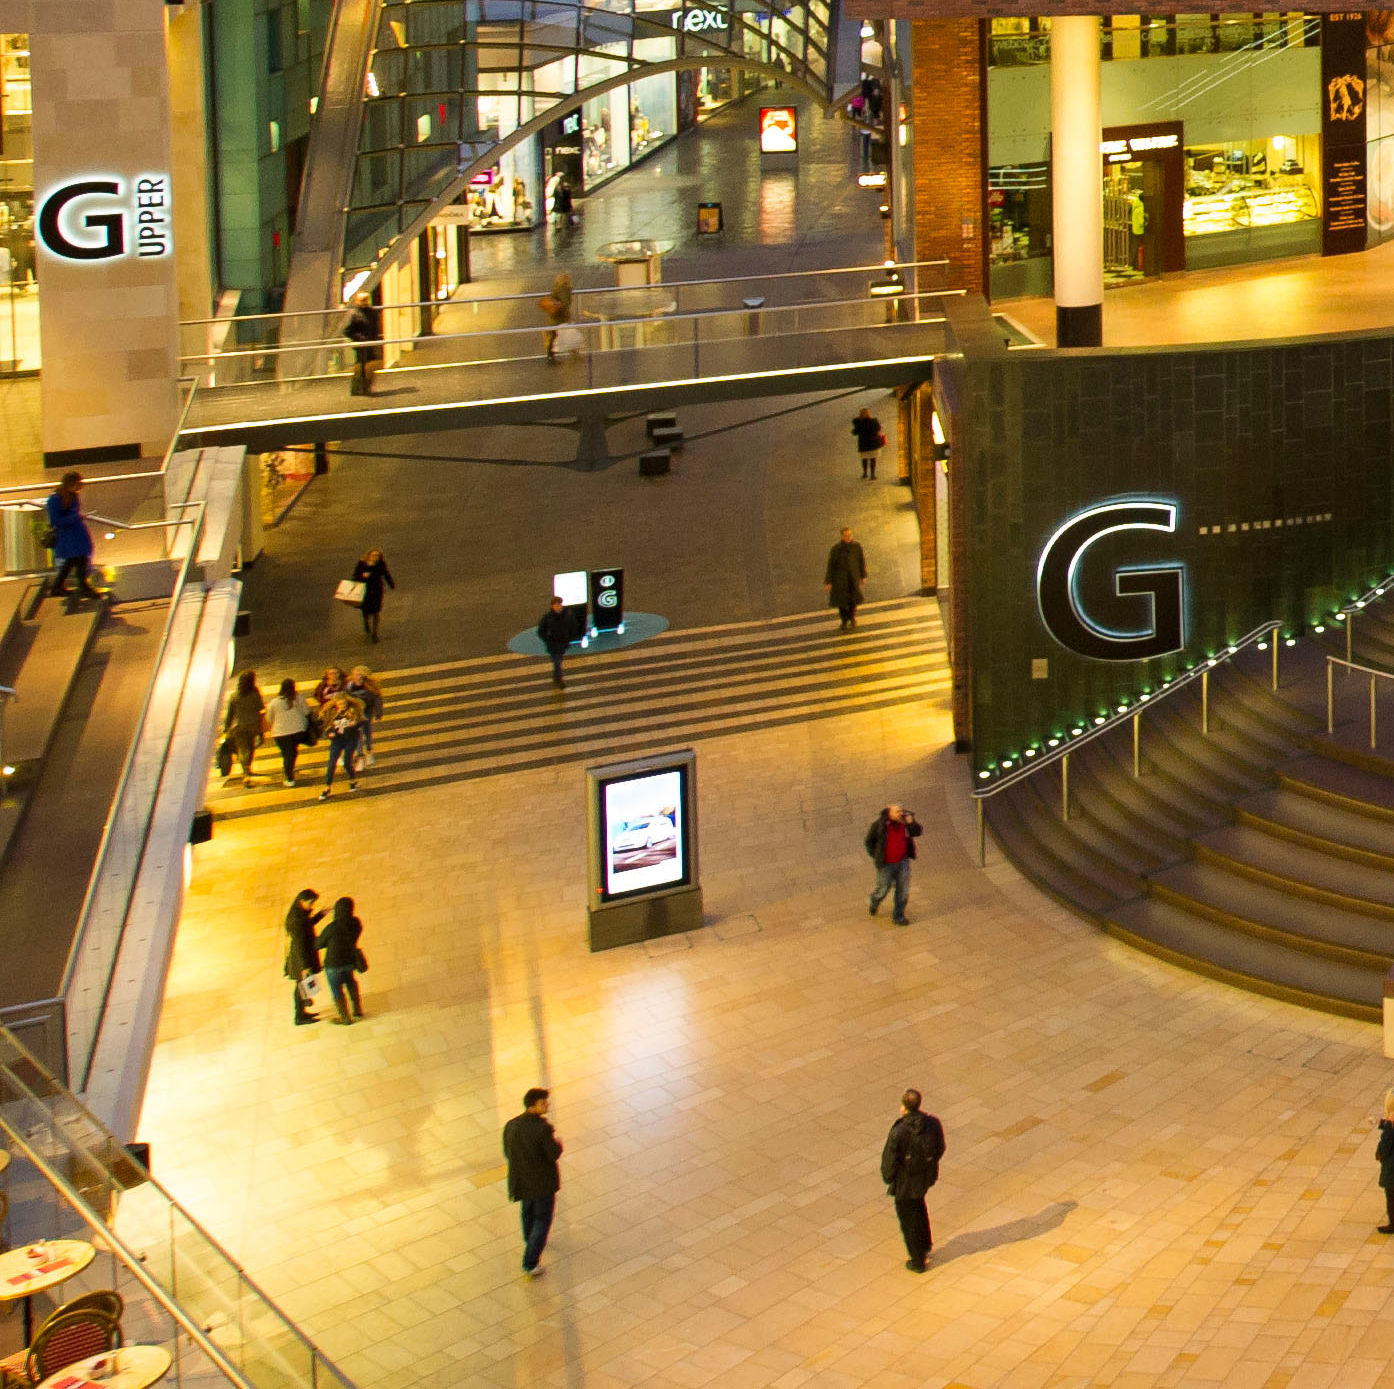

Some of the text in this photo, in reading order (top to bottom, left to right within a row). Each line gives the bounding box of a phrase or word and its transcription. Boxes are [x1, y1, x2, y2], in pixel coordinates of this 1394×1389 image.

[39, 181, 125, 259] G
[138, 179, 166, 257] UPPER
[598, 588, 618, 608] G
[1037, 499, 1185, 661] G
